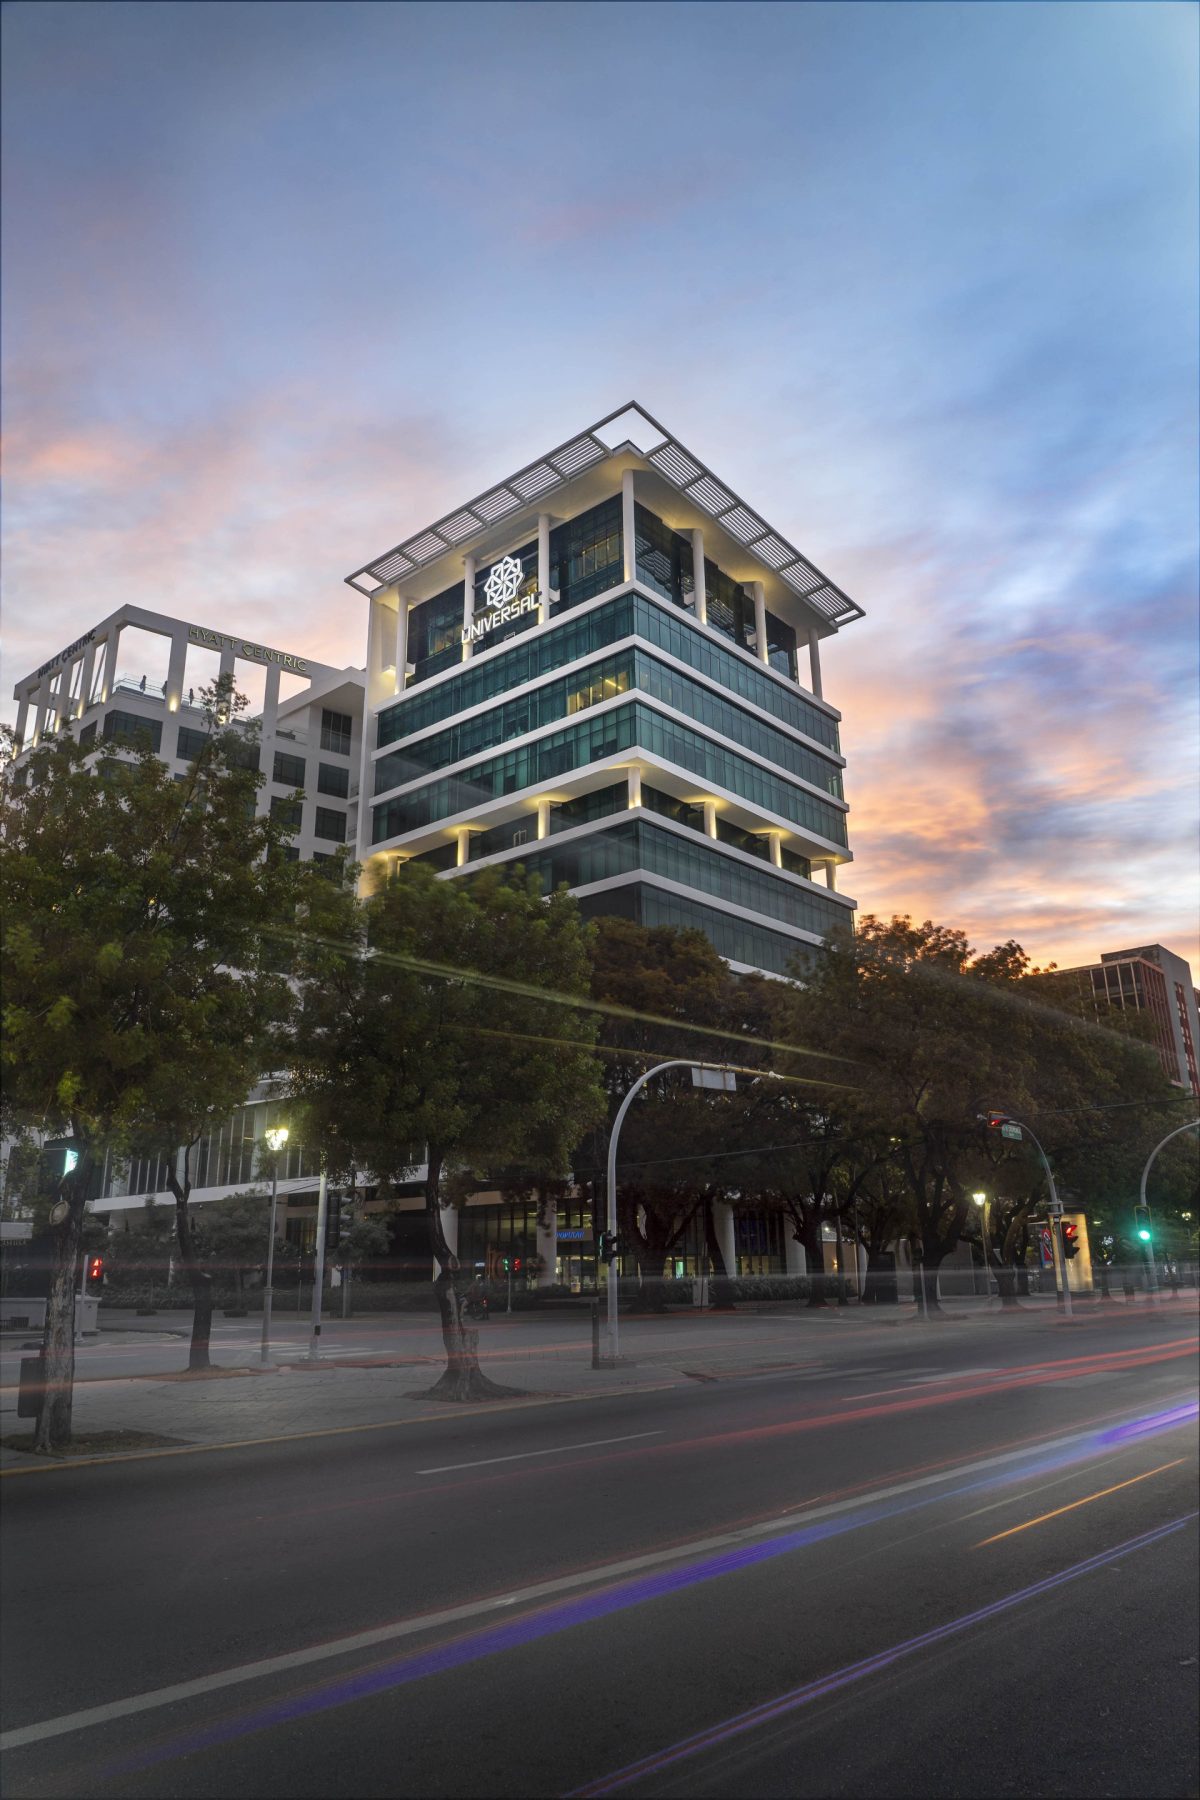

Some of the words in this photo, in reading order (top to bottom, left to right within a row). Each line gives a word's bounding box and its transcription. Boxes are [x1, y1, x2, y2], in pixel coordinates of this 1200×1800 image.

[461, 592, 541, 643] UNIVERSAL
[188, 625, 238, 650] HYATT
[242, 643, 308, 672] CENTRIC
